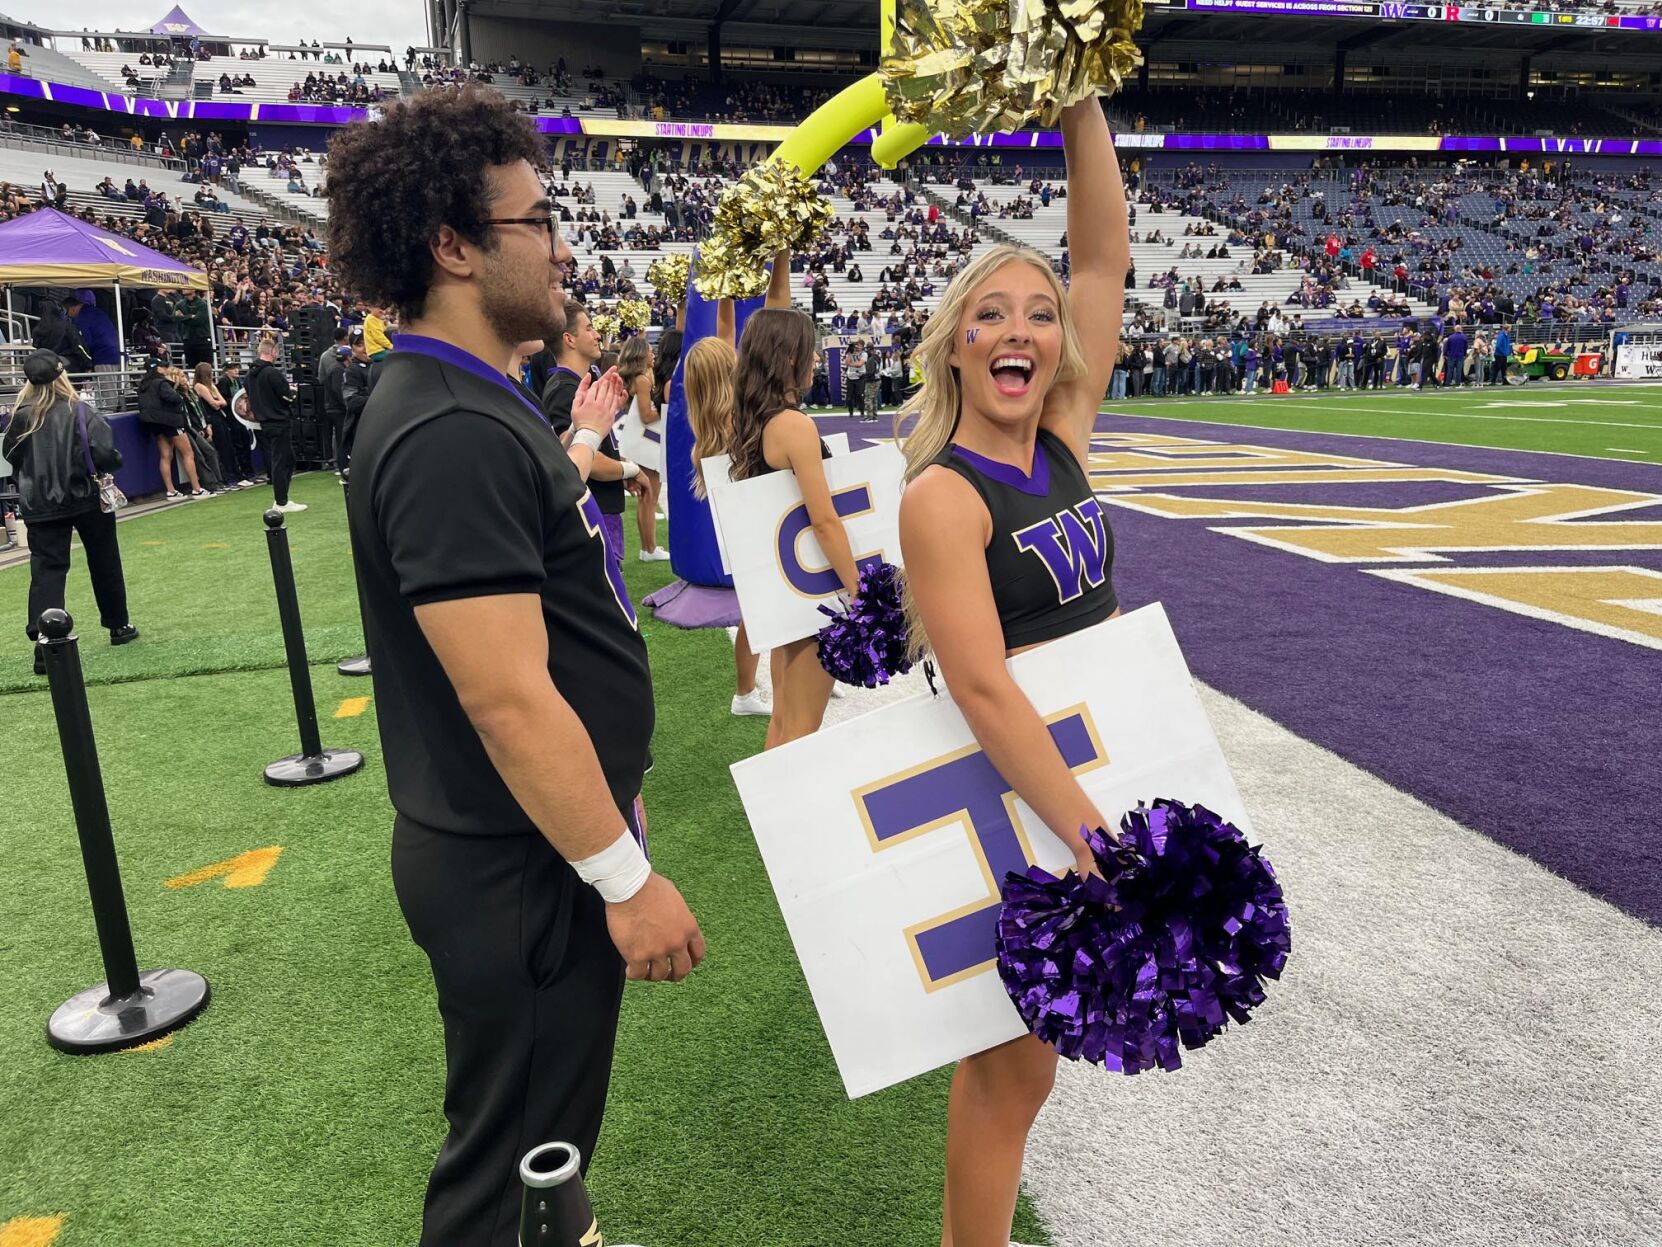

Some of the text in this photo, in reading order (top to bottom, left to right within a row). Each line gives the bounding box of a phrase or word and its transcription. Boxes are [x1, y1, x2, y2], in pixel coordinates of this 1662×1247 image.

[1256, 1, 1285, 9] SERVICES
[1337, 4, 1363, 12] SECTION
[1383, 3, 1406, 18] W
[1427, 6, 1437, 18] 0
[1446, 5, 1461, 21] R
[1484, 9, 1494, 21] 0
[655, 123, 713, 137] STARTING LINEUPS
[1326, 137, 1373, 148] STARTING LINEUPS
[141, 269, 190, 285] WASHINGTON
[838, 337, 850, 345] W
[870, 336, 882, 345] W
[966, 328, 981, 344] W
[1588, 358, 1598, 369] G
[1011, 496, 1107, 606] W
